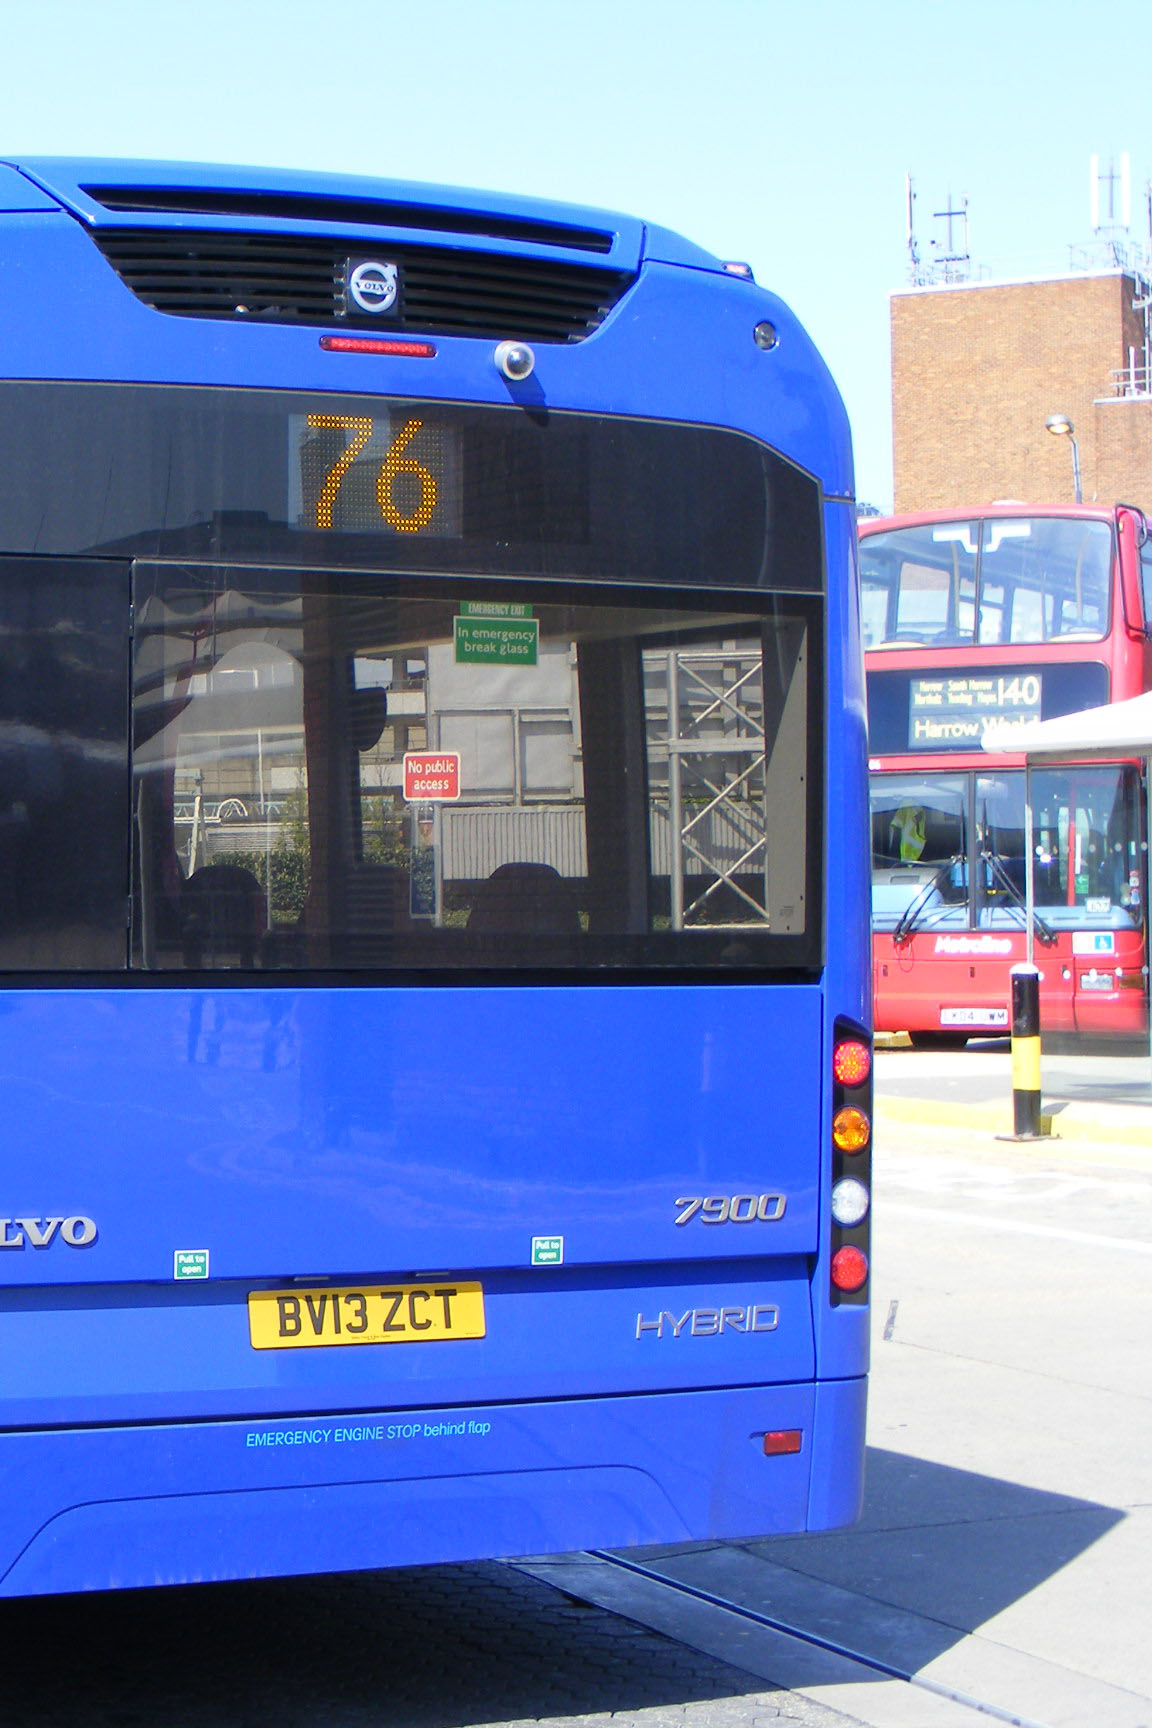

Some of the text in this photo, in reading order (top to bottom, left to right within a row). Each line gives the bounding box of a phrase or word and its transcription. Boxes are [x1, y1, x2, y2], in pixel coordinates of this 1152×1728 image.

[354, 282, 395, 292] VOLVO
[307, 414, 437, 532] 76
[468, 602, 526, 616] EMERGENCY EXIT
[458, 627, 536, 643] In emergency
[464, 641, 529, 656] break glass
[997, 675, 1040, 706] 140
[914, 719, 979, 738] Harrow
[408, 759, 455, 776] No public
[413, 779, 450, 790] access
[674, 1193, 787, 1225] 7900
[178, 1254, 205, 1264] Pull to
[181, 1265, 202, 1275] open
[276, 1288, 458, 1338] BV13 ZCT
[635, 1304, 779, 1340] HYBRID
[246, 1420, 492, 1448] EMERGENCY ENGINE STOP behind flap
